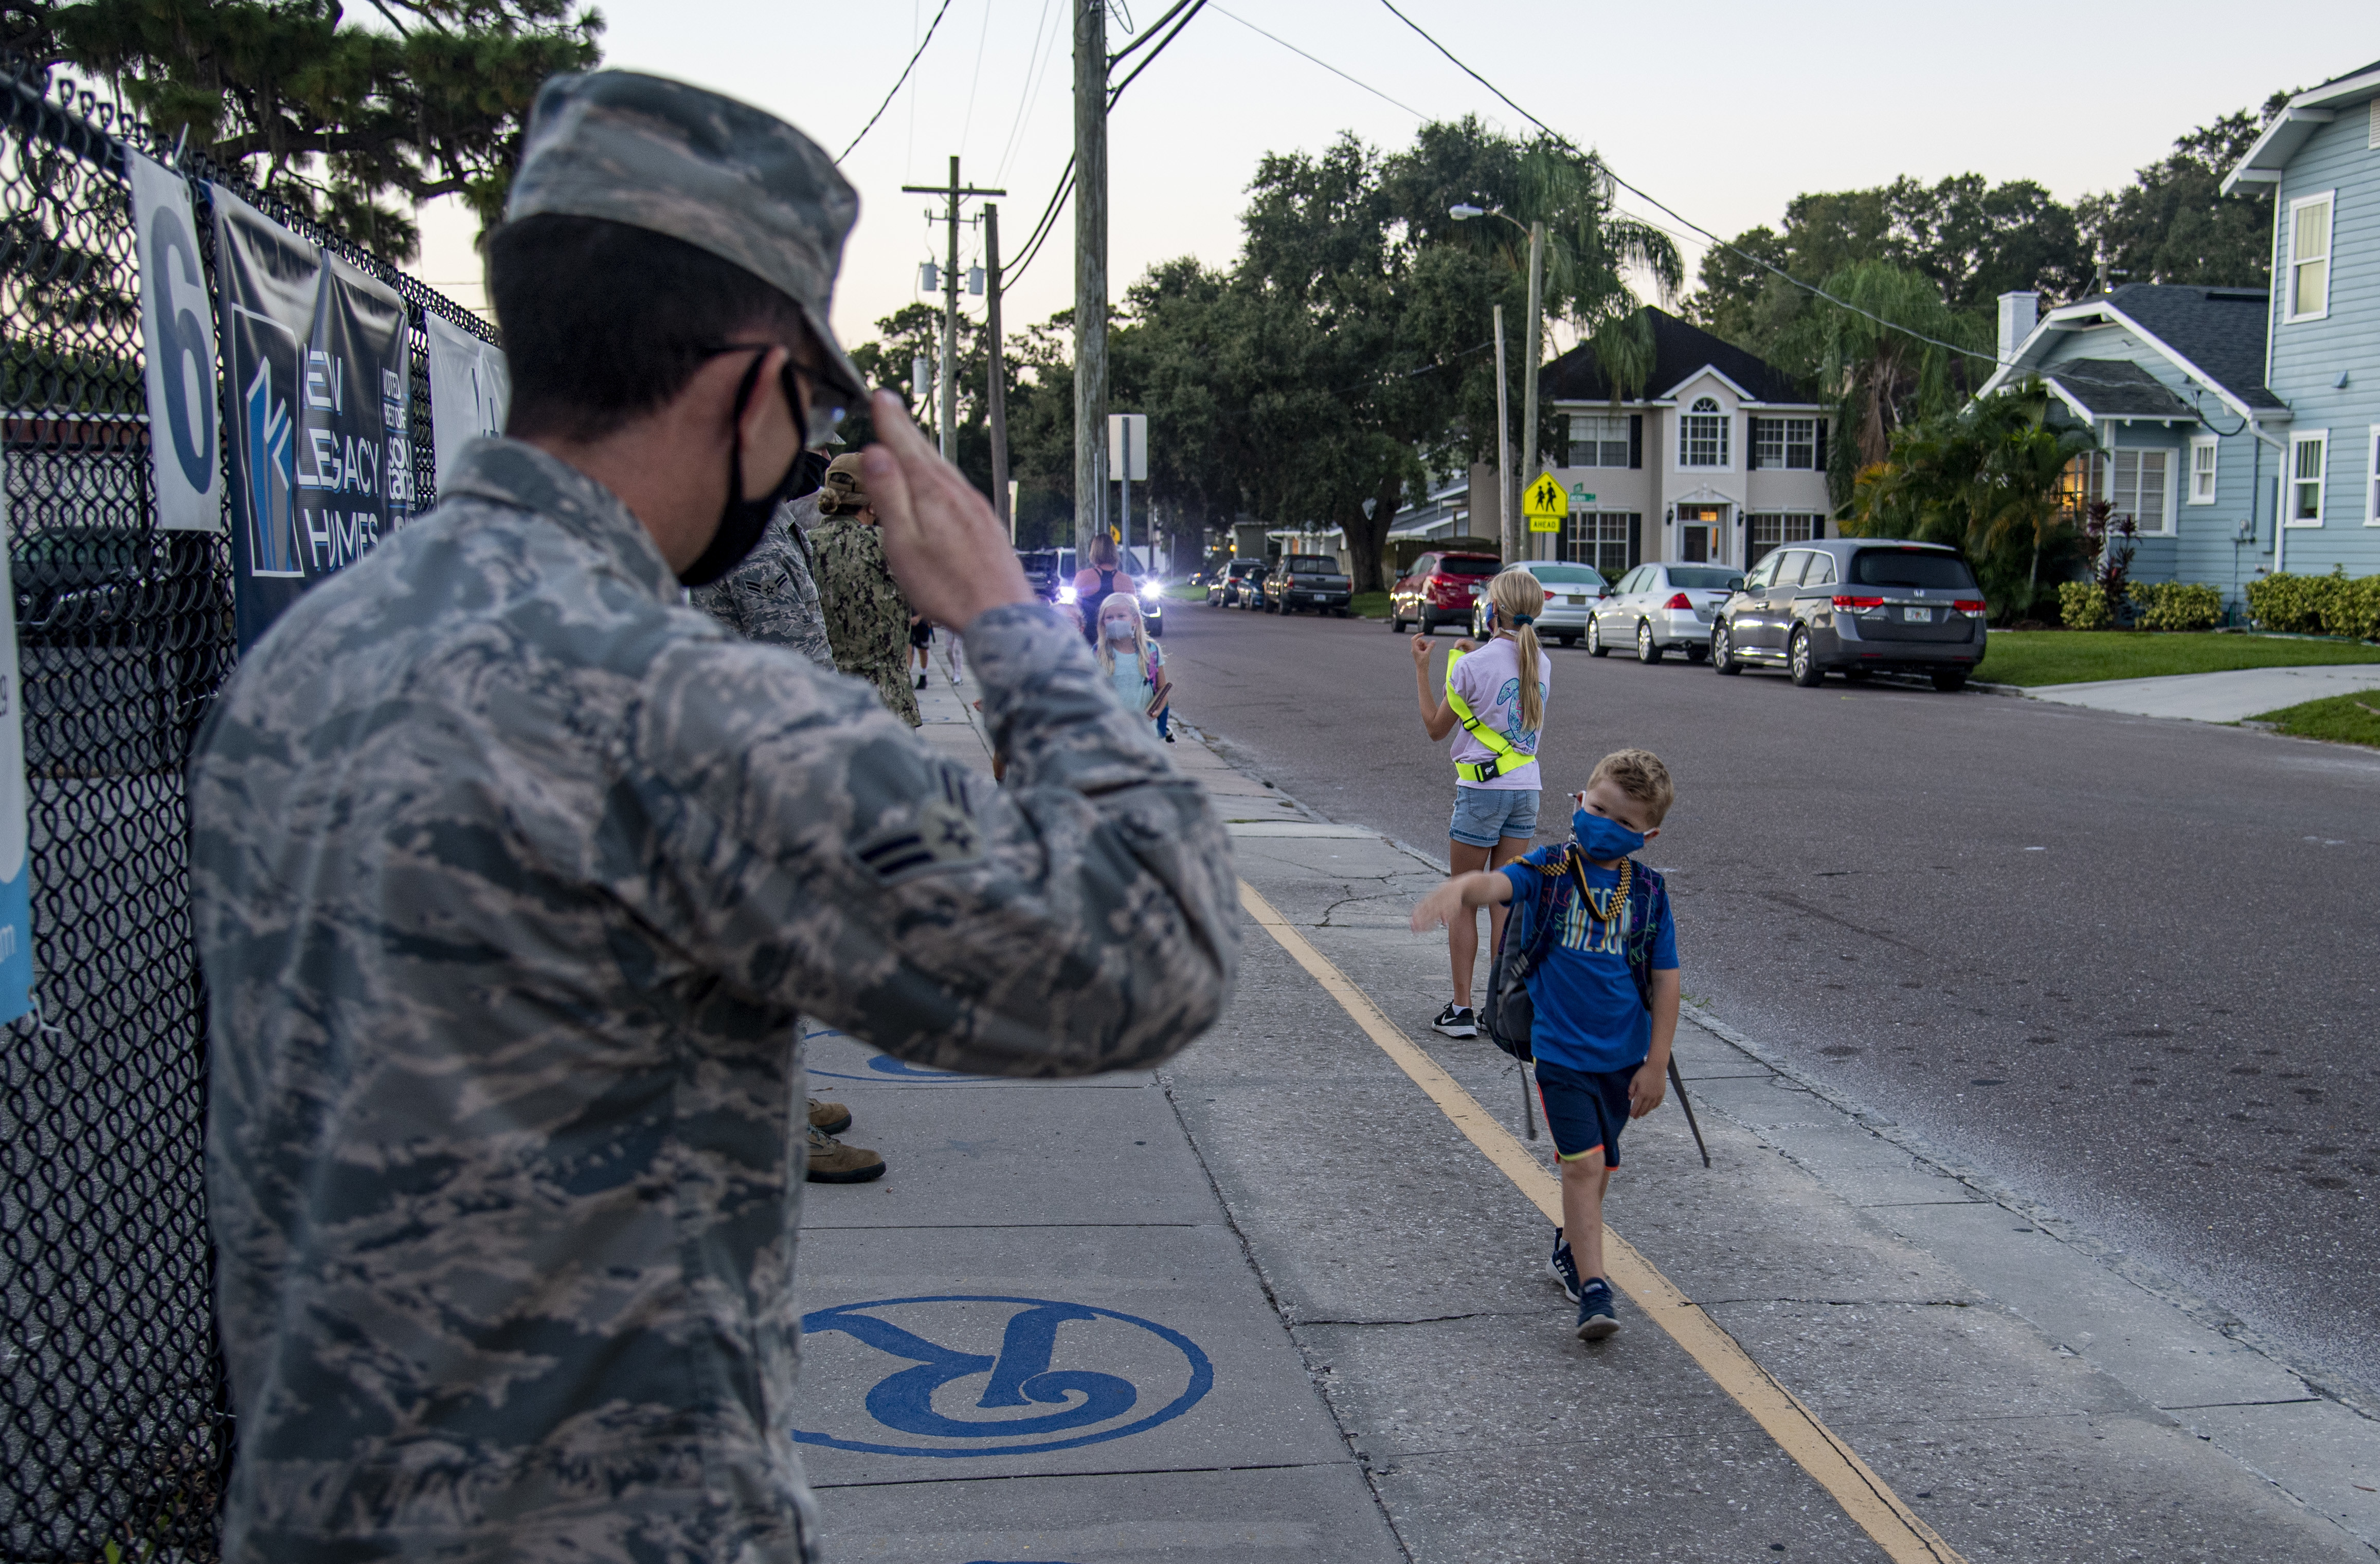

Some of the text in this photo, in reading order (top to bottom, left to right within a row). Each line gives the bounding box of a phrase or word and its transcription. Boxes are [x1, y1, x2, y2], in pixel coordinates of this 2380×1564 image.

[303, 343, 344, 416] EW
[395, 407, 406, 429] OF
[296, 428, 380, 497] LEGACY
